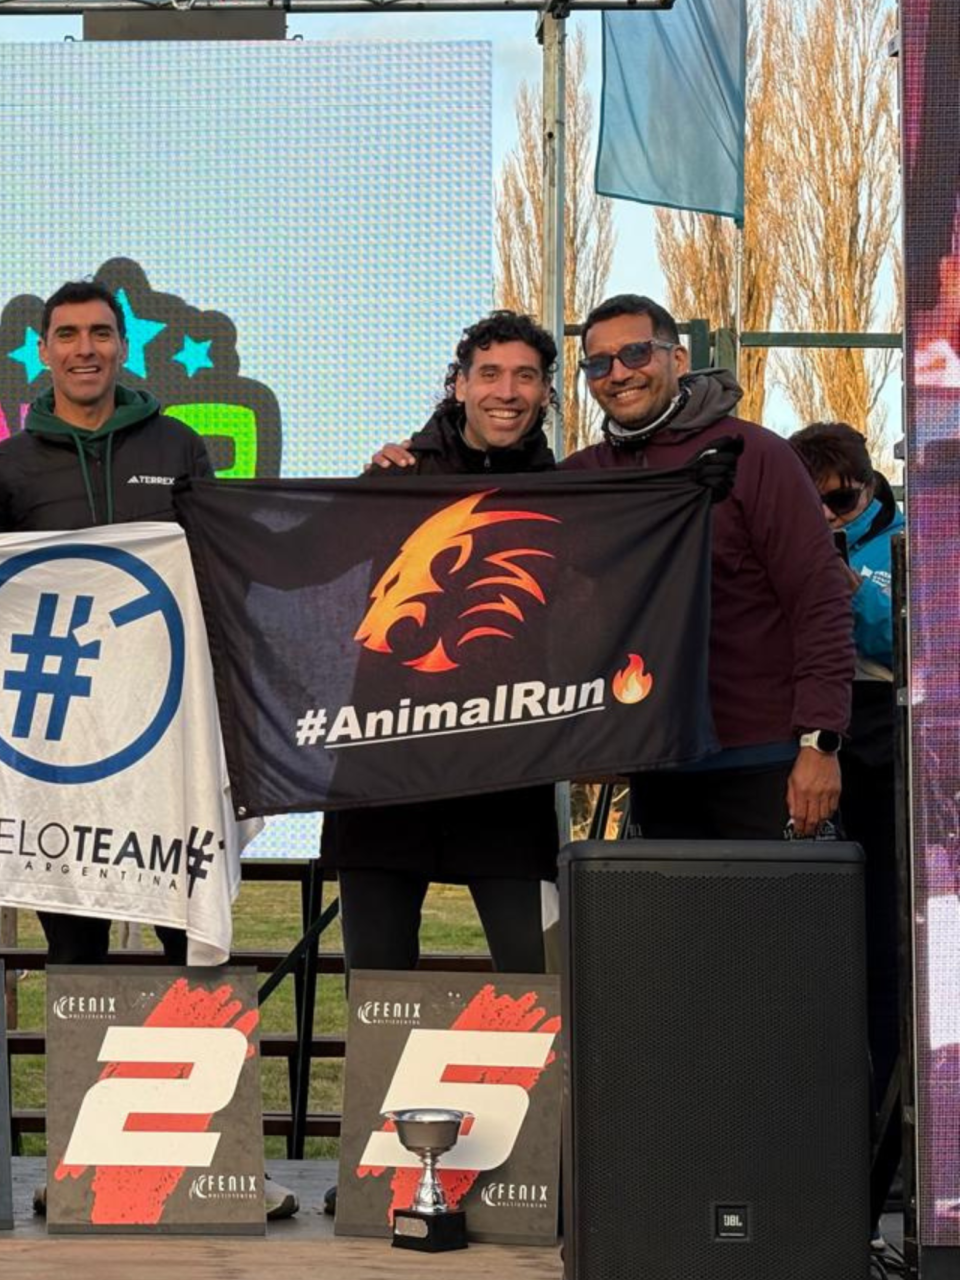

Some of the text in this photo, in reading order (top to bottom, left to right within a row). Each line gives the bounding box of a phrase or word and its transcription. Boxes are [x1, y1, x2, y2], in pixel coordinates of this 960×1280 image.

[296, 676, 606, 746] #AnimalRun
[25, 861, 178, 890] ARGENTINA
[68, 996, 115, 1012] FENIX
[373, 1001, 421, 1018] FENIX
[63, 1026, 248, 1166] 2
[359, 1029, 556, 1171] 5
[208, 1175, 256, 1192] FENIX
[497, 1183, 547, 1201] FENIX
[723, 1214, 743, 1227] JBL
